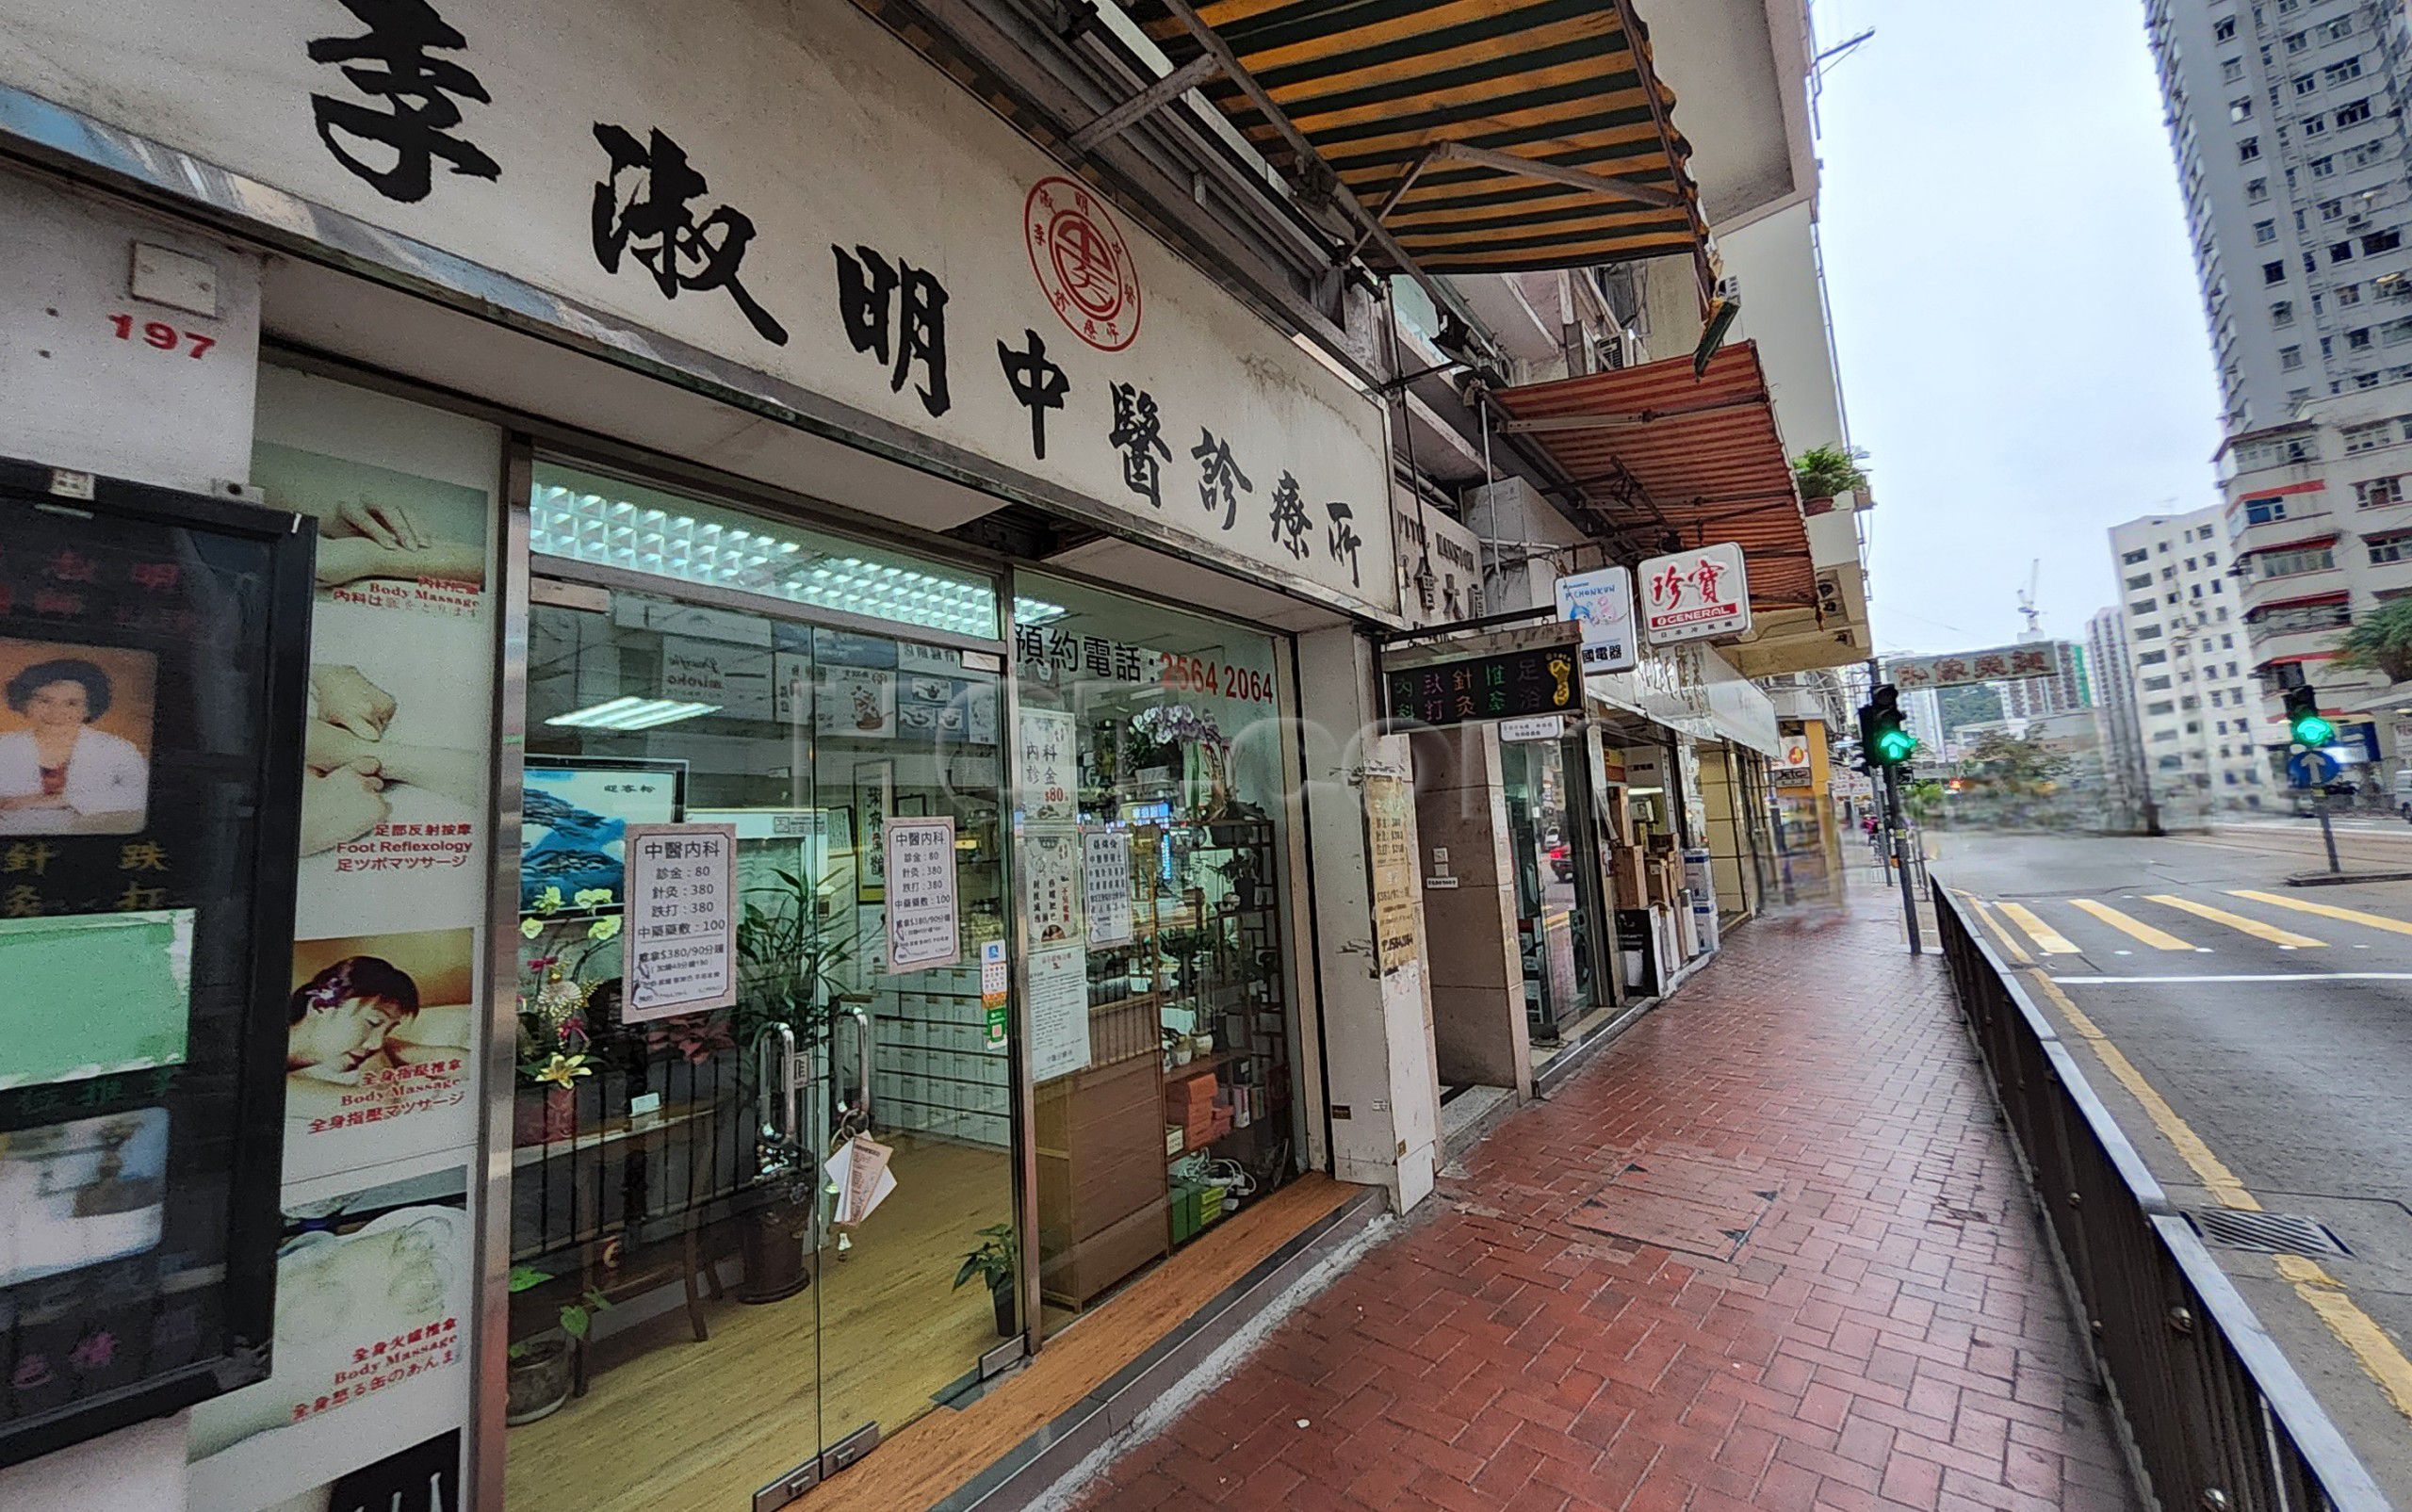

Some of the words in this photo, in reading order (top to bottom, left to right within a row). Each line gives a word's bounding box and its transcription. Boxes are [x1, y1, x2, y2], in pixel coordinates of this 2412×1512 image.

[109, 314, 217, 360] 197
[1668, 606, 1731, 625] GENERAL
[1160, 651, 1219, 696] 2564
[1225, 664, 1274, 705] 2064
[1452, 667, 1476, 718] 針灸
[336, 841, 376, 854] Foot
[380, 839, 473, 855] Reflexology
[341, 1091, 383, 1107] Body
[391, 1078, 461, 1097] Massage
[334, 1361, 382, 1386] Body
[386, 1334, 458, 1366] Massage
